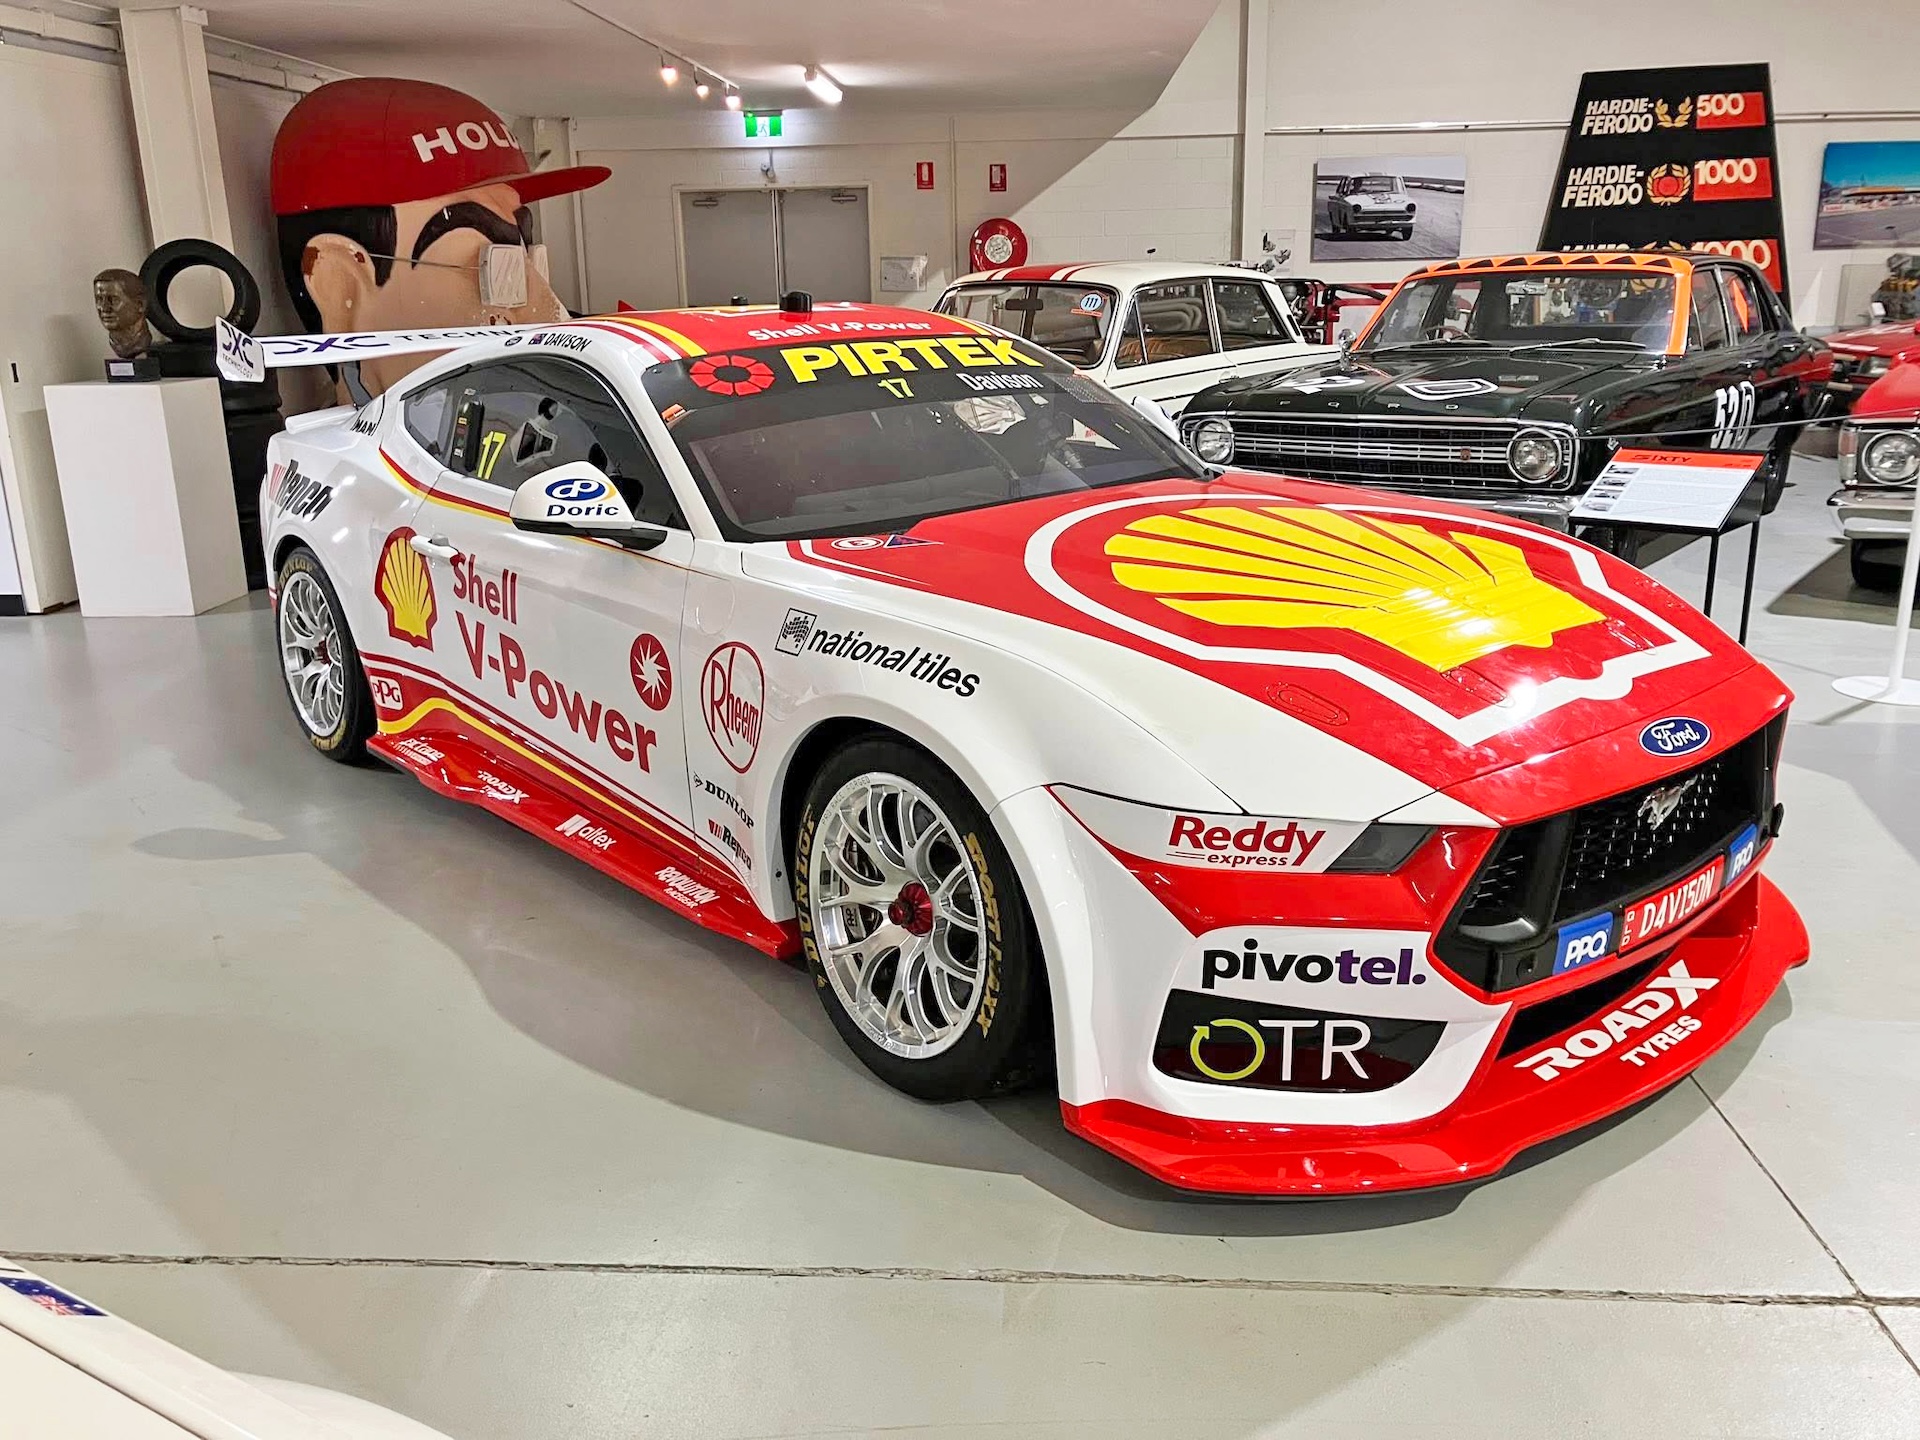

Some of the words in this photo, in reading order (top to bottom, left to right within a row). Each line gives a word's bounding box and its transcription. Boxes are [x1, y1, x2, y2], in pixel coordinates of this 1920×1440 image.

[1586, 97, 1654, 116] HARDIE-
[1697, 93, 1745, 117] 500
[1581, 113, 1653, 136] FERODO
[1567, 164, 1645, 186] HARDIE-
[1695, 158, 1757, 184] 1000
[1562, 184, 1643, 208] FERODO
[395, 329, 526, 341] TECHN
[543, 333, 592, 352] DAVISON
[748, 323, 820, 341] Shell
[821, 321, 931, 333] V-Power
[780, 336, 1044, 383] PIRTEK
[877, 377, 915, 399] 17
[956, 371, 1044, 391] Davison
[477, 431, 507, 480] 17
[1631, 453, 1693, 464] SIXTY
[275, 459, 334, 522] Repco
[547, 504, 619, 517] Doric
[450, 552, 518, 625] Shell
[807, 629, 921, 673] national
[910, 653, 980, 697] tiles
[373, 679, 401, 705] PPG
[455, 610, 657, 774] V-Power
[711, 647, 759, 748] Rheem
[1651, 722, 1700, 751] Ford
[705, 780, 755, 829] DUNLOP
[722, 825, 752, 870] Repco
[1169, 815, 1327, 867] Reddy
[1732, 841, 1754, 878] PPQ
[1207, 853, 1289, 868] express
[655, 866, 721, 904] REVOLUTION
[795, 803, 821, 962] DUNLOP
[1202, 938, 1427, 990] pivotel.
[1564, 931, 1607, 968] PPQ
[1514, 959, 1720, 1082] ROADX
[1190, 1018, 1371, 1081] OTR
[1620, 1015, 1703, 1067] TYRES
